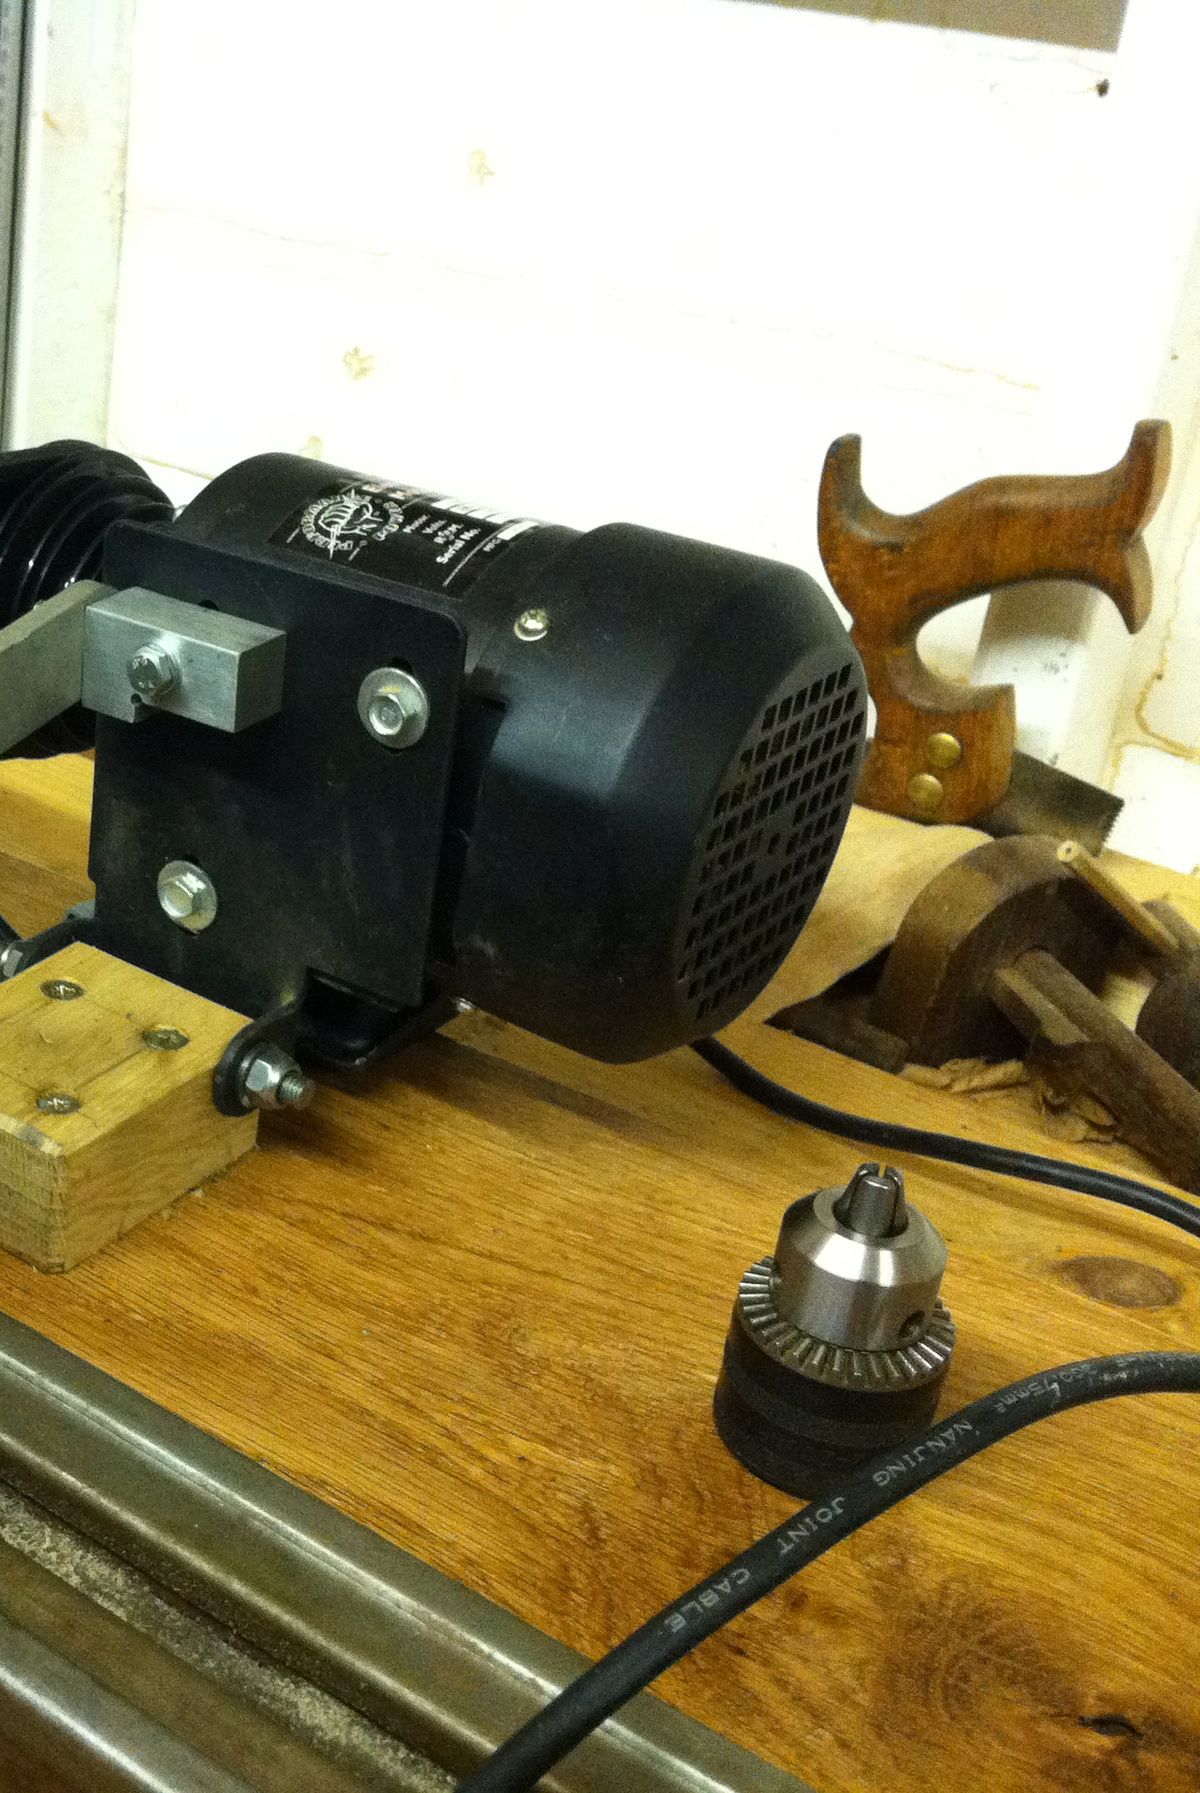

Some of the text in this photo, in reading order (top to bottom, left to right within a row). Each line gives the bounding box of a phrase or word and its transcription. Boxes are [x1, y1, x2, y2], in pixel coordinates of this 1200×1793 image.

[872, 1420, 972, 1487] NANJING
[776, 1497, 845, 1556] JOINT
[664, 1568, 751, 1634] CABLE
